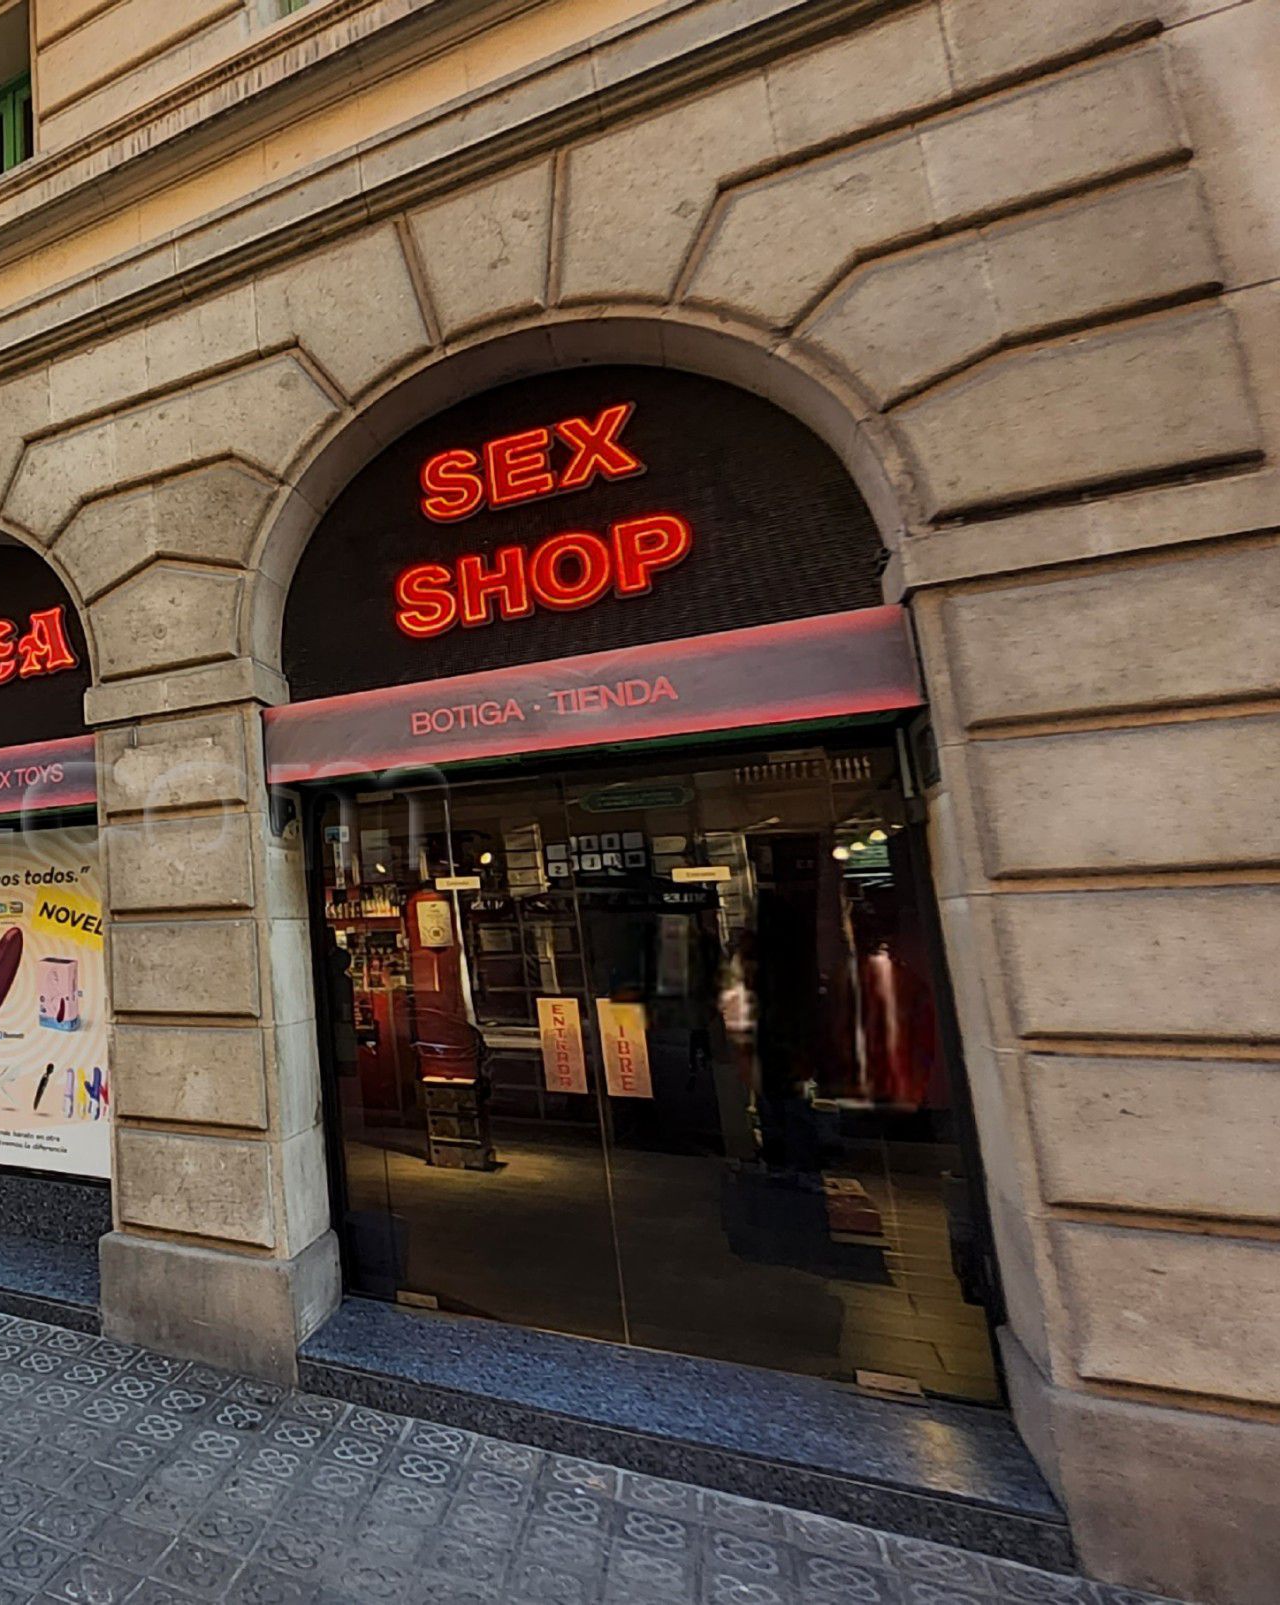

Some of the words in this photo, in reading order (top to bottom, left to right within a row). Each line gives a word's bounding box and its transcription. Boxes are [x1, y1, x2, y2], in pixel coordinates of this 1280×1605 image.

[422, 402, 645, 521] SEX
[395, 514, 692, 637] SHOP
[411, 699, 525, 736] BOTIGA
[548, 675, 678, 715] TIENDA
[14, 763, 65, 787] TOYS
[551, 1004, 573, 1088] ENTRADA
[617, 1025, 637, 1092] IBRE
